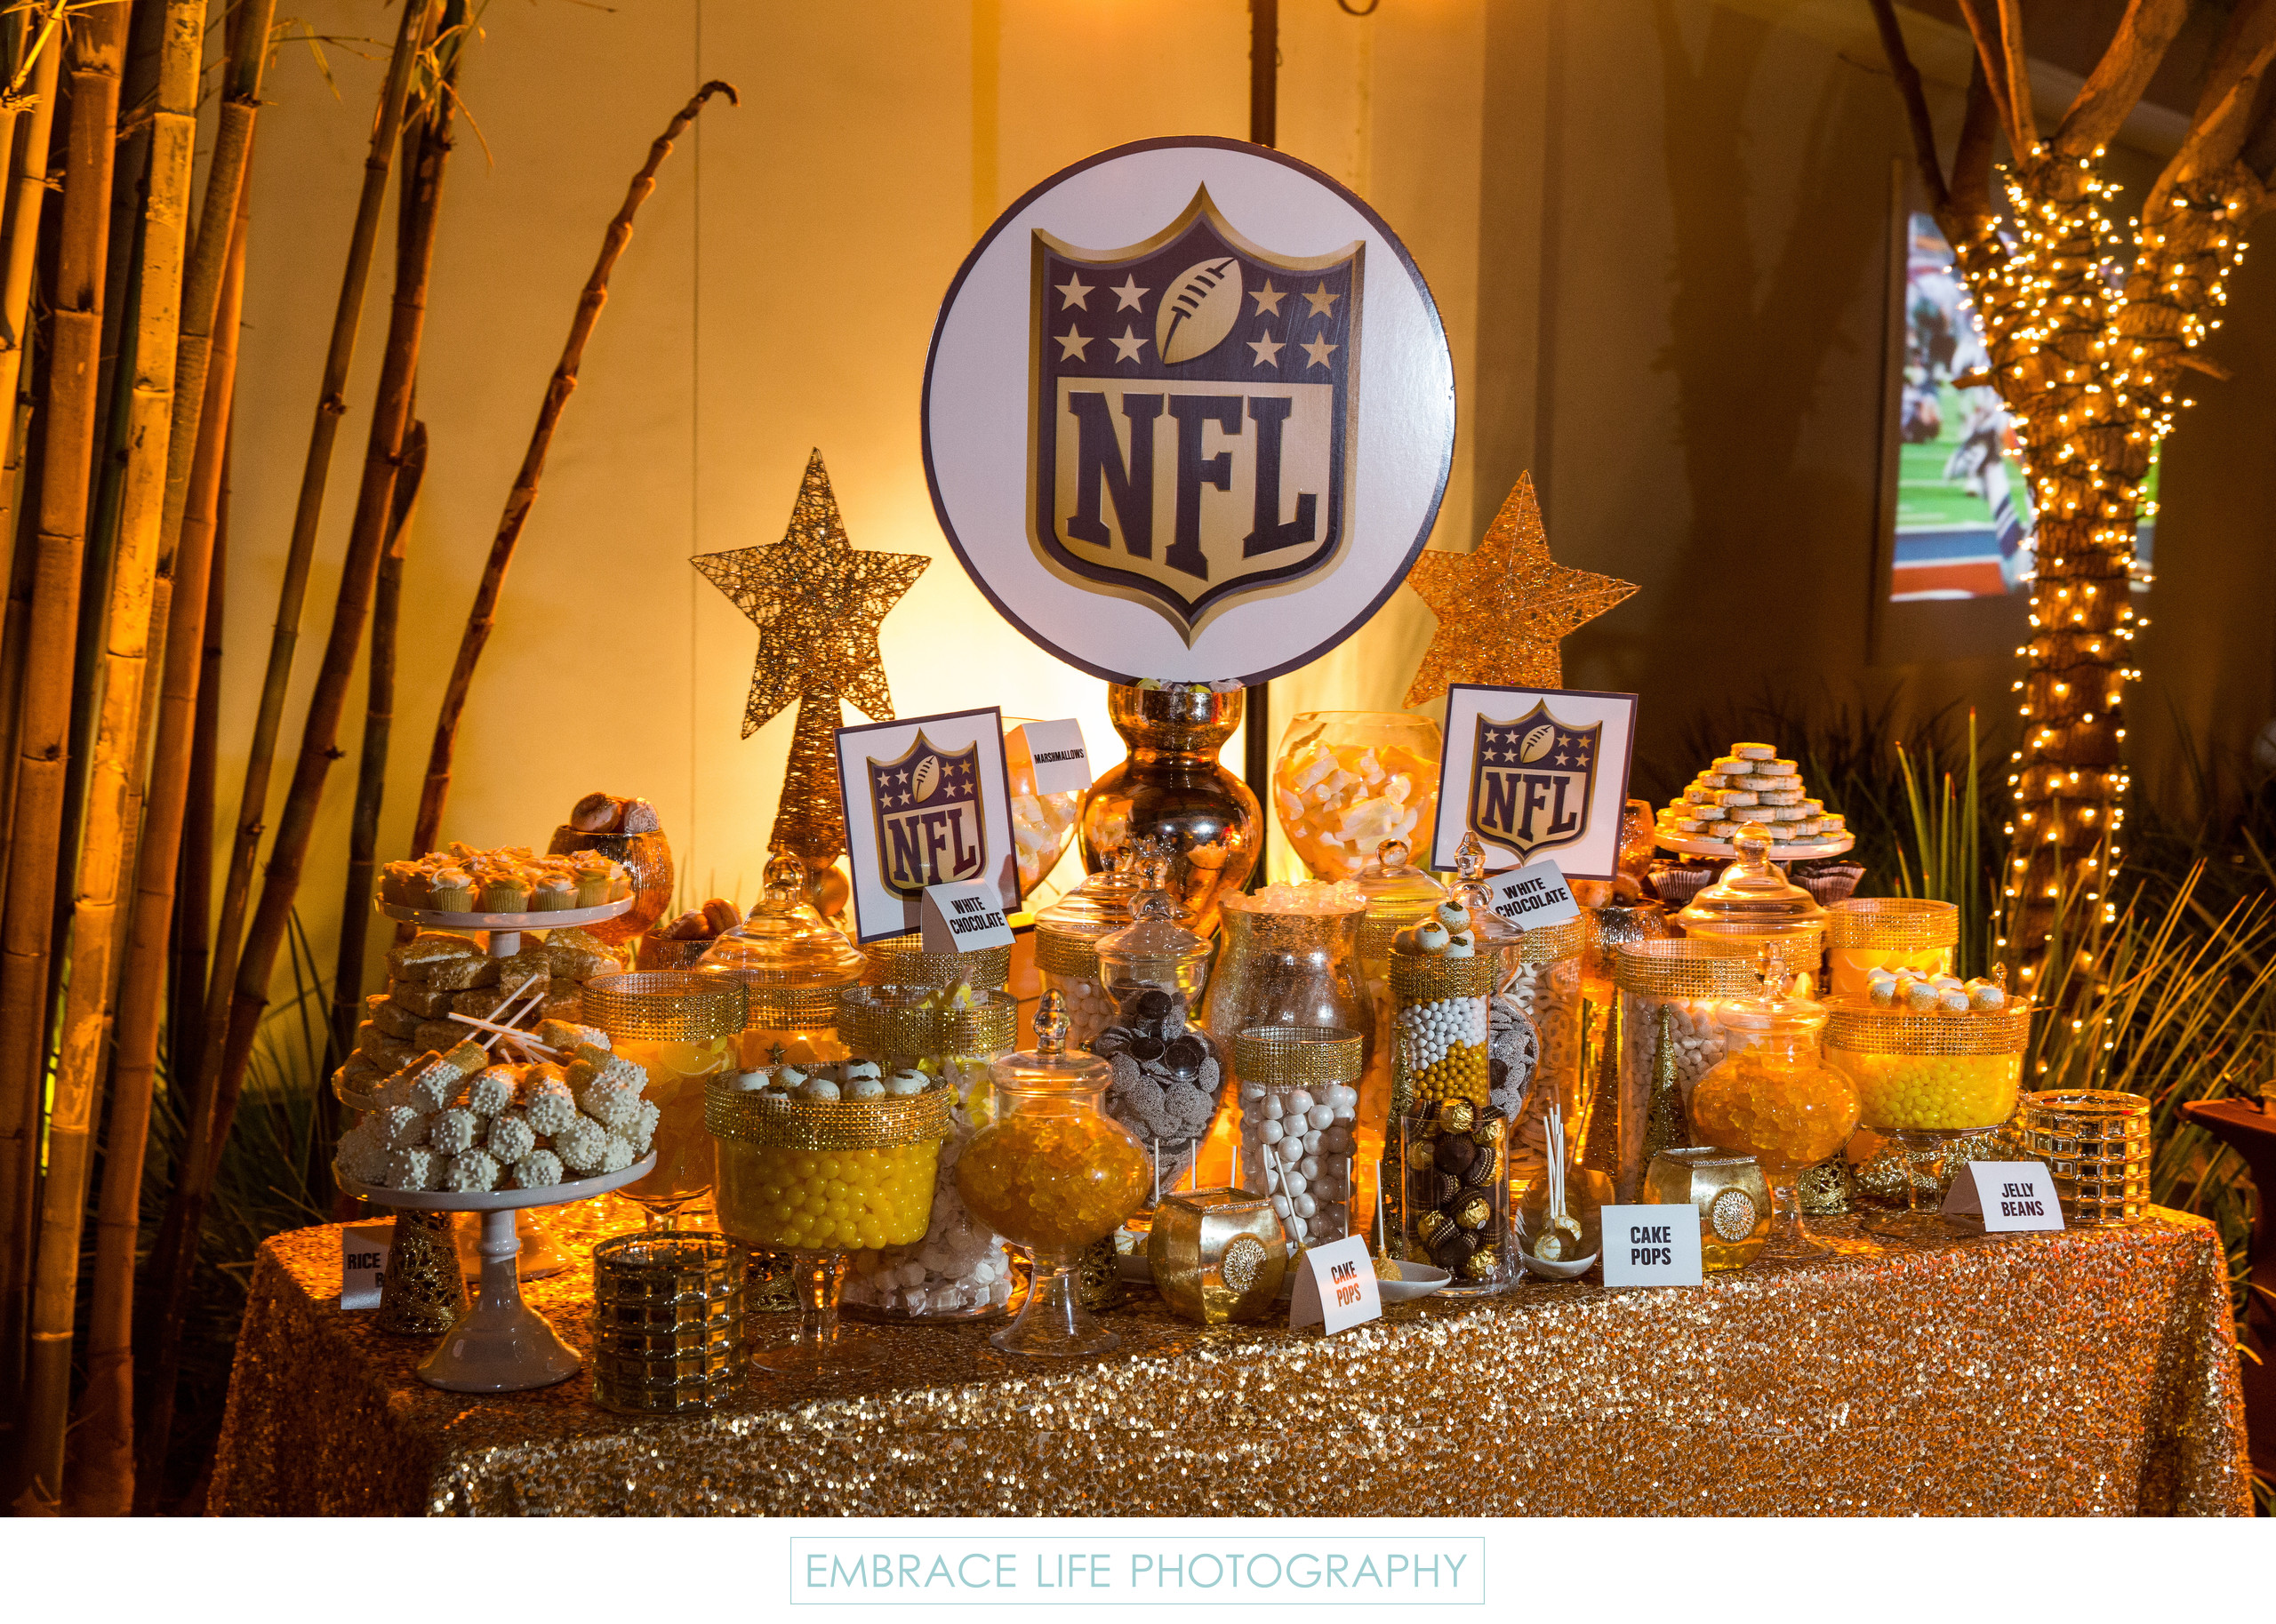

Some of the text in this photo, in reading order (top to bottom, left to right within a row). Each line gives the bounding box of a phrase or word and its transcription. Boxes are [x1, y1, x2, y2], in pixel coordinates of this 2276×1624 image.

[1067, 391, 1318, 582] NFL
[1034, 748, 1085, 764] MARSHMALLOWS
[1481, 772, 1577, 843] NFL
[887, 808, 978, 884] NFL
[1503, 876, 1546, 900] WHITE
[950, 897, 986, 914] WHITE
[1495, 887, 1568, 919] CHOCOLATE
[949, 912, 1005, 934] CHOCOLATE
[2001, 1183, 2034, 1198] JELLY
[2000, 1200, 2045, 1217] BEANS
[1630, 1226, 1671, 1244] CAKE
[347, 1252, 381, 1269] RICE
[1631, 1247, 1671, 1266] POPS
[1330, 1260, 1358, 1284] CAKE
[1336, 1283, 1361, 1308] POPS
